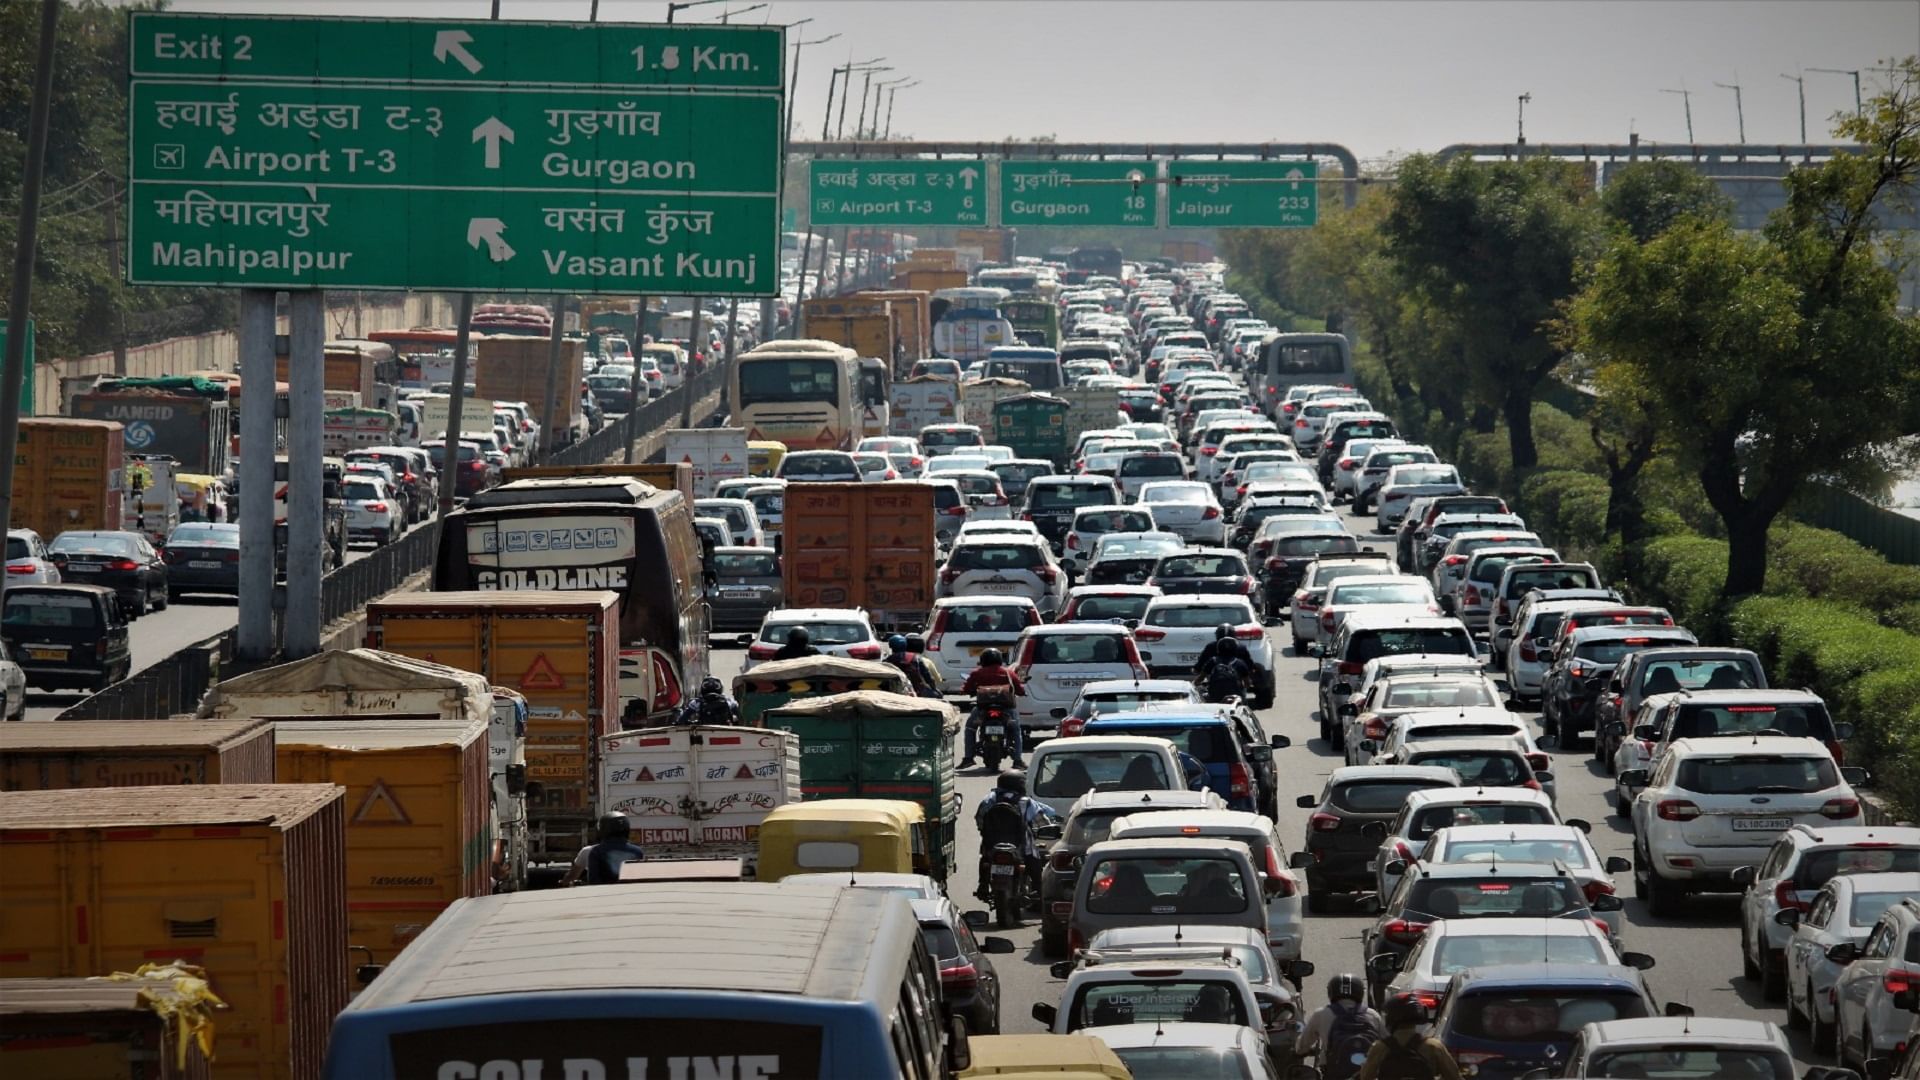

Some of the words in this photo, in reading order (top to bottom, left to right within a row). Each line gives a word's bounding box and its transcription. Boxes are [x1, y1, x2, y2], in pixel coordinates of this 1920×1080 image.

[155, 33, 222, 59] Exit
[233, 35, 252, 60] 2
[693, 46, 759, 72] Km.
[155, 92, 239, 135] हवाई
[258, 102, 361, 138] अड्डा
[384, 106, 443, 137] ट-३
[544, 101, 661, 145] गुड़गाँव
[204, 145, 330, 176] Airport
[342, 148, 396, 173] T-3
[542, 152, 696, 184] Gurgaon
[817, 168, 859, 188] हवाई
[840, 201, 900, 216] Airport
[906, 200, 932, 213] T-3
[963, 196, 973, 208] 6
[1011, 200, 1090, 218] Gurgaon
[1125, 196, 1145, 209] 18
[1176, 202, 1233, 217] Jaipur
[1278, 197, 1310, 209] 233
[154, 189, 331, 237] महिपालपुर
[541, 201, 625, 233] वसंत
[645, 203, 714, 244] कुंज
[152, 242, 353, 276] Mahipalpur
[542, 249, 664, 277] Vasant
[676, 252, 756, 284] Kunj
[105, 405, 174, 420] JANGID
[478, 566, 628, 591] GOLDLINE
[746, 792, 770, 805] SIDE
[644, 829, 689, 843] SLOW
[704, 828, 744, 841] HORN
[1108, 994, 1144, 1005] Uber
